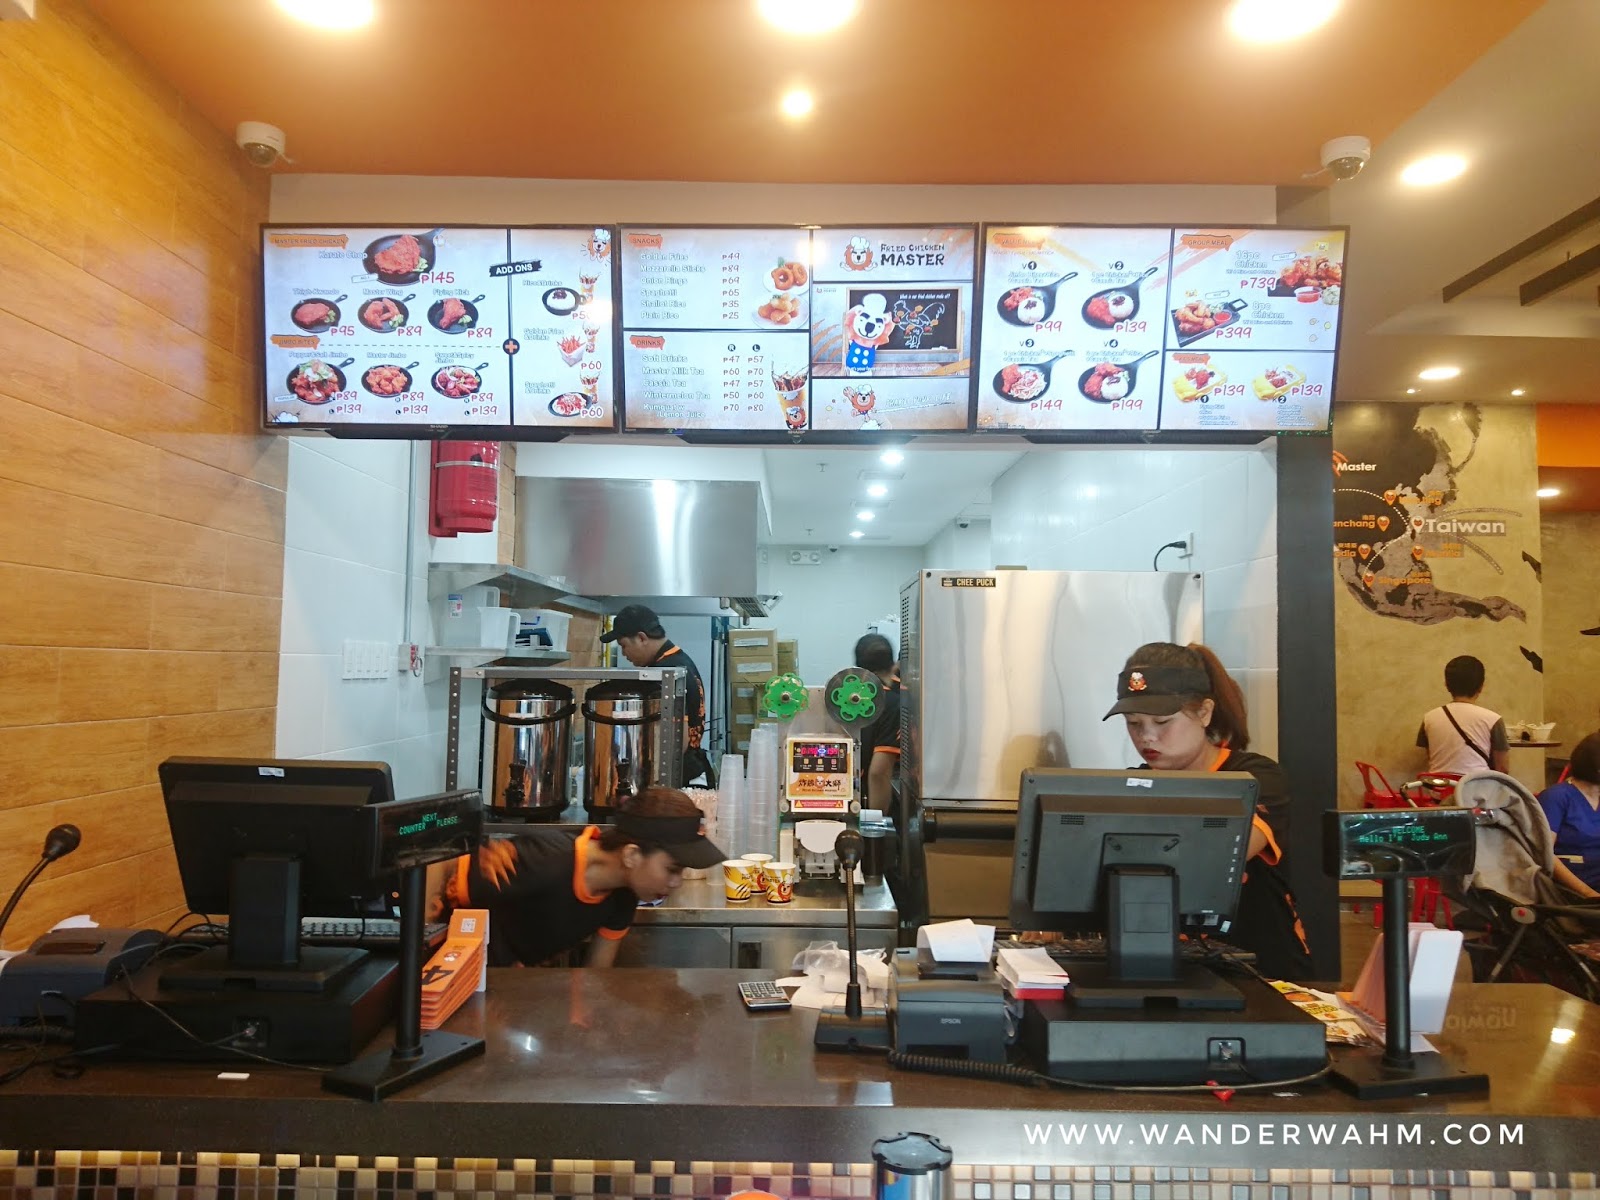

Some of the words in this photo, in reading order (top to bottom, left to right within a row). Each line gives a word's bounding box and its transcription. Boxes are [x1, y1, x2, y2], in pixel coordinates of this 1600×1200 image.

[880, 243, 906, 252] FRIED
[908, 243, 945, 251] CHICKEN
[880, 253, 945, 266] MASTER
[1235, 259, 1268, 268] Chicken
[496, 265, 514, 275] ADD
[514, 263, 533, 273] ONS
[1251, 310, 1284, 319] Chicken
[690, 367, 704, 375] Tea
[1336, 462, 1377, 471] Master
[1426, 518, 1505, 533] Taiwan
[956, 578, 974, 586] CHEE
[976, 578, 994, 586] PUCK
[1378, 577, 1431, 586] Singapore
[422, 812, 438, 823] NEXT
[399, 822, 426, 836] COUNTER
[436, 815, 459, 828] PLEASE
[1392, 825, 1425, 834] WELCOME
[1359, 834, 1384, 843] Hello
[1433, 833, 1448, 841] Ann
